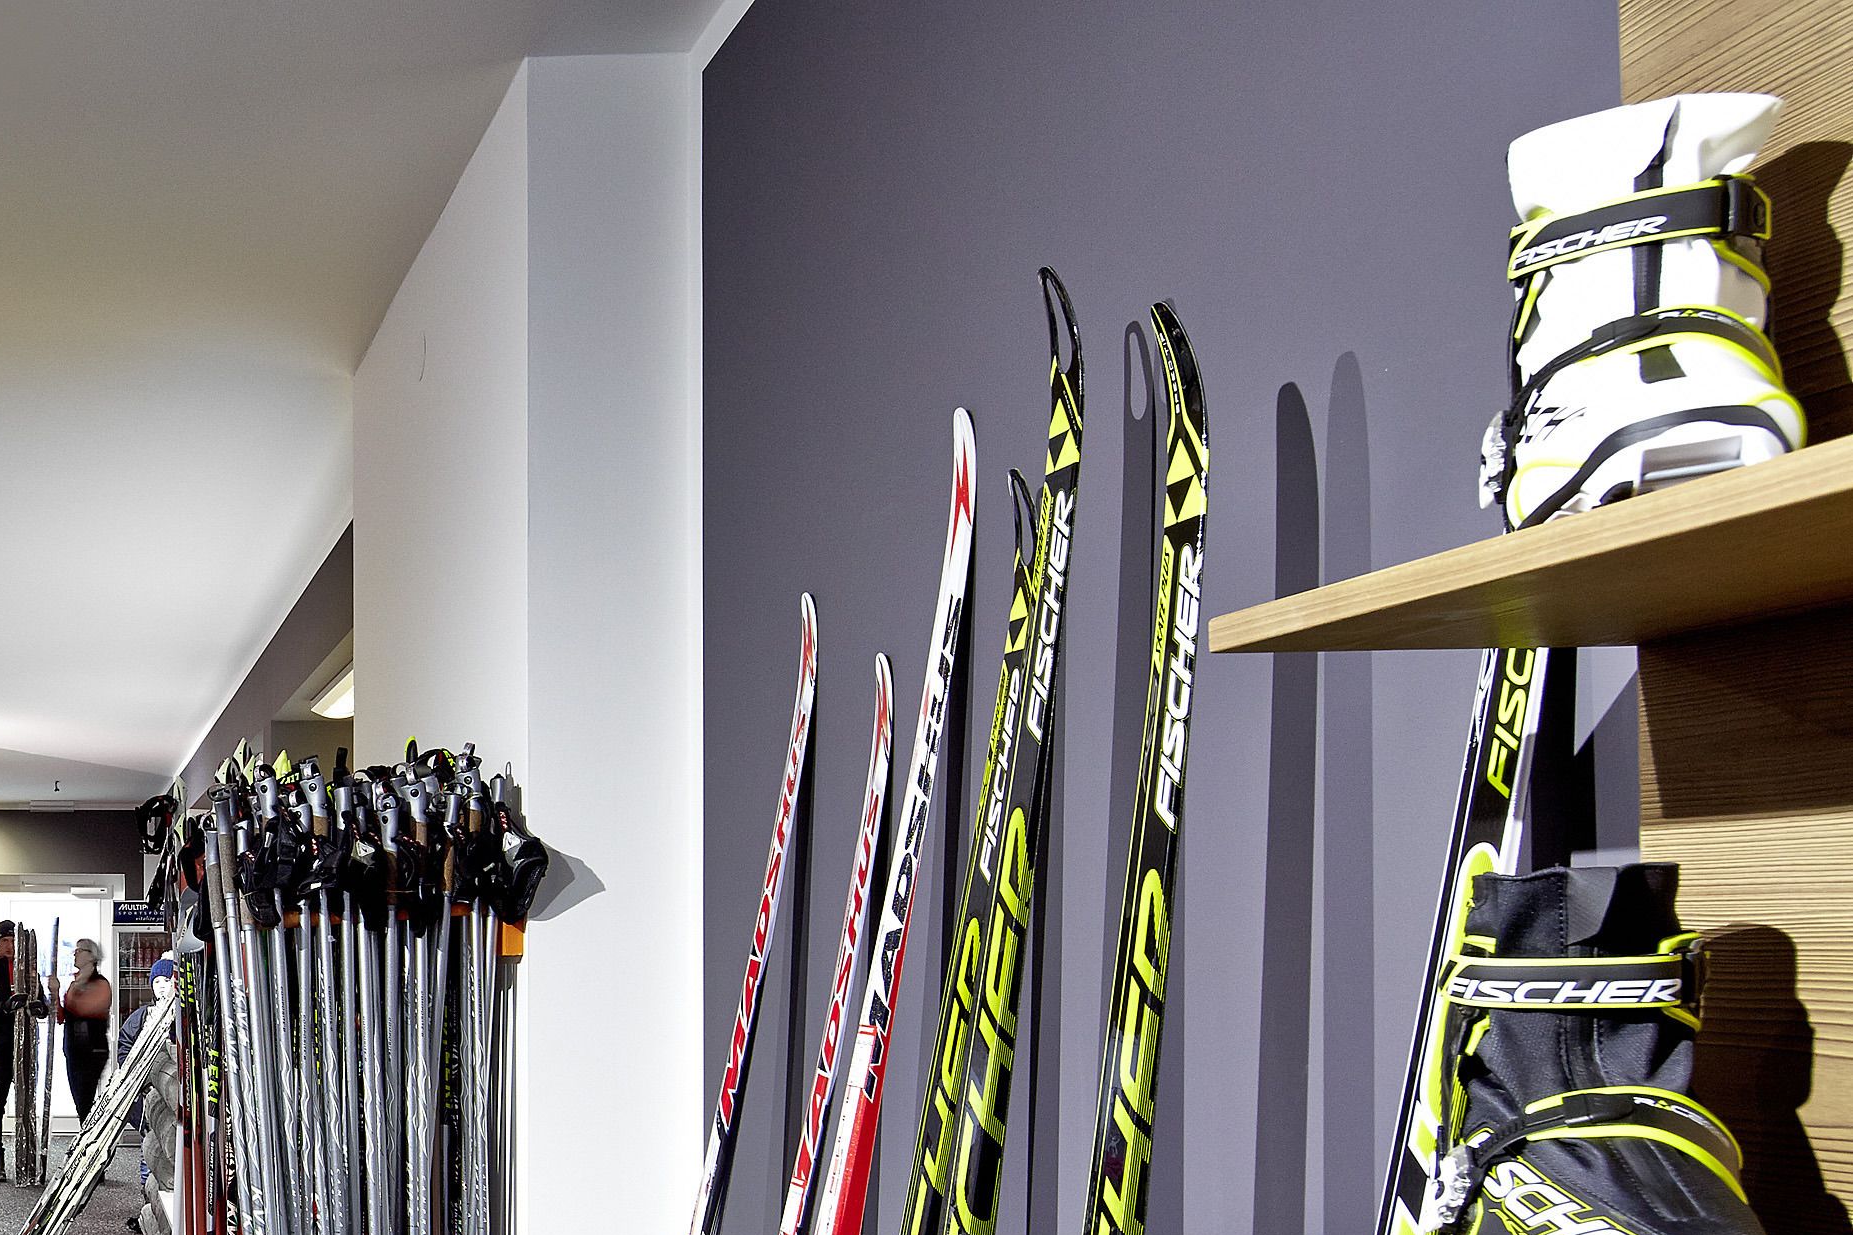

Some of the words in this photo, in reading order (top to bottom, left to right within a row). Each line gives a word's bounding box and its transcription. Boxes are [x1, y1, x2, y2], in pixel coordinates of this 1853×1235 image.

[1513, 214, 1667, 271] FISCHER
[1027, 489, 1077, 744] FISCHER
[1153, 542, 1201, 834] FISCHER
[1155, 600, 1165, 654] SKATE
[1160, 546, 1170, 598] PLUS
[980, 666, 1020, 885] FISCHER
[1486, 646, 1536, 800] FISC
[718, 709, 807, 1124] MADSHUS
[863, 595, 961, 1100] MADSHUS
[208, 1049, 220, 1104] LEKI
[1447, 977, 1683, 1003] FISCHER
